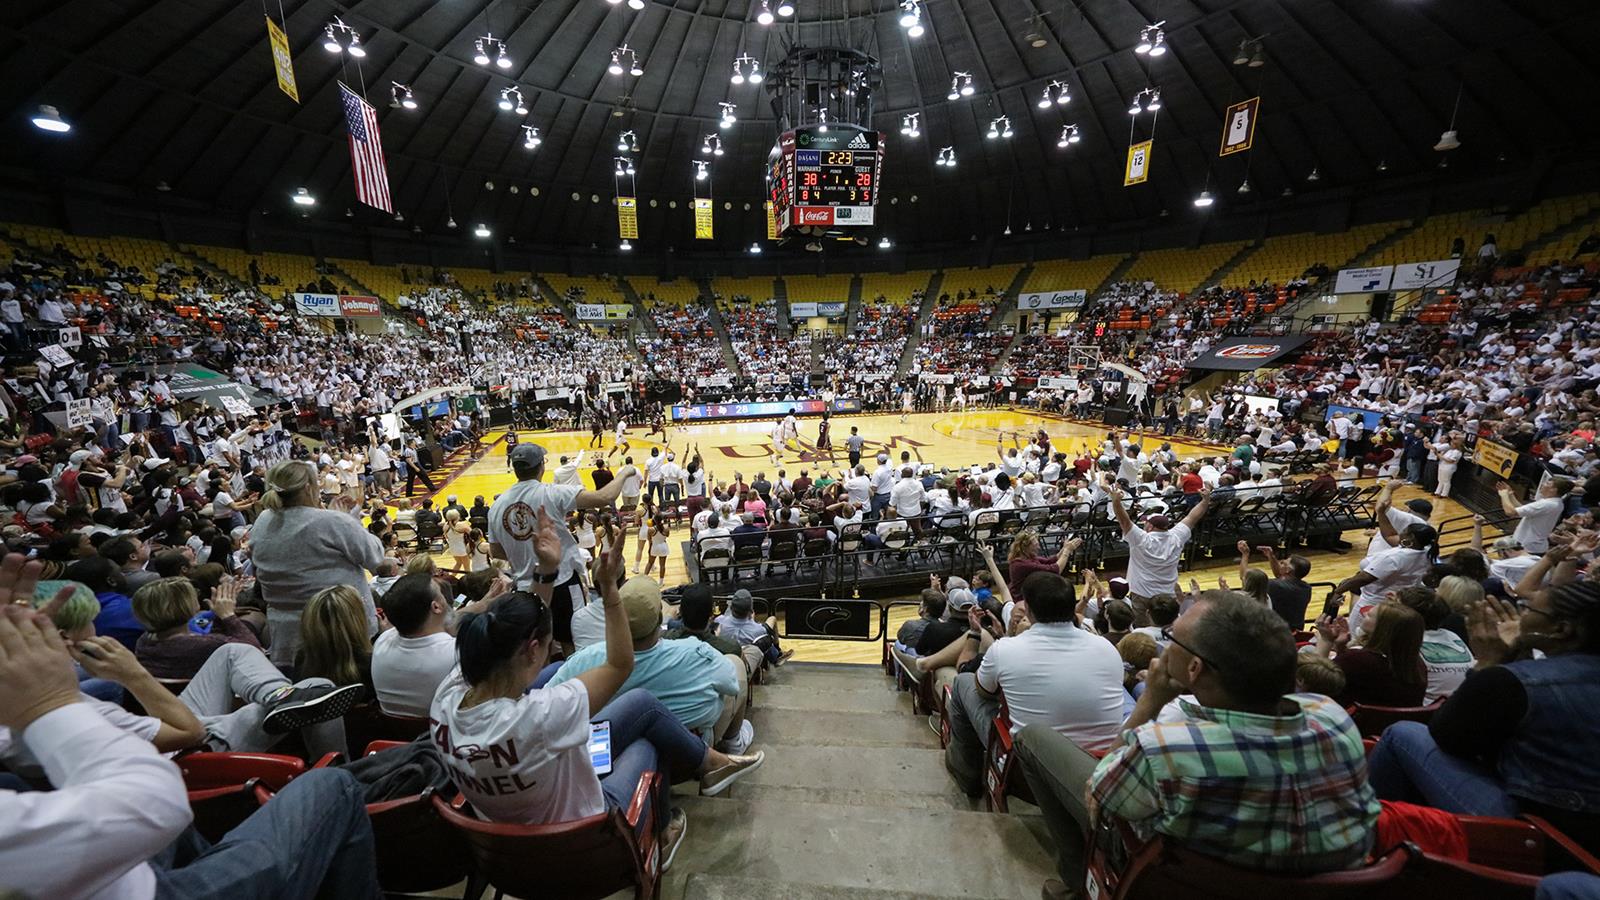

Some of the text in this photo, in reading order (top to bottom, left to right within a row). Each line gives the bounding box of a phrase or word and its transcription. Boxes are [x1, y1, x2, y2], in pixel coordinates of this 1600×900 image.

[1236, 119, 1243, 130] 5
[847, 141, 870, 149] adidas
[828, 151, 852, 165] 2:23
[1134, 156, 1143, 166] 12
[855, 165, 871, 173] GUEST
[803, 172, 818, 186] 38
[856, 173, 871, 186] 28
[802, 190, 809, 200] 8
[813, 191, 820, 200] 4
[850, 191, 856, 201] 3
[863, 191, 870, 201] 5
[303, 294, 334, 307] Ryan
[1051, 291, 1083, 305] Lapels
[343, 299, 379, 313] Johnny's
[736, 405, 749, 414] 28
